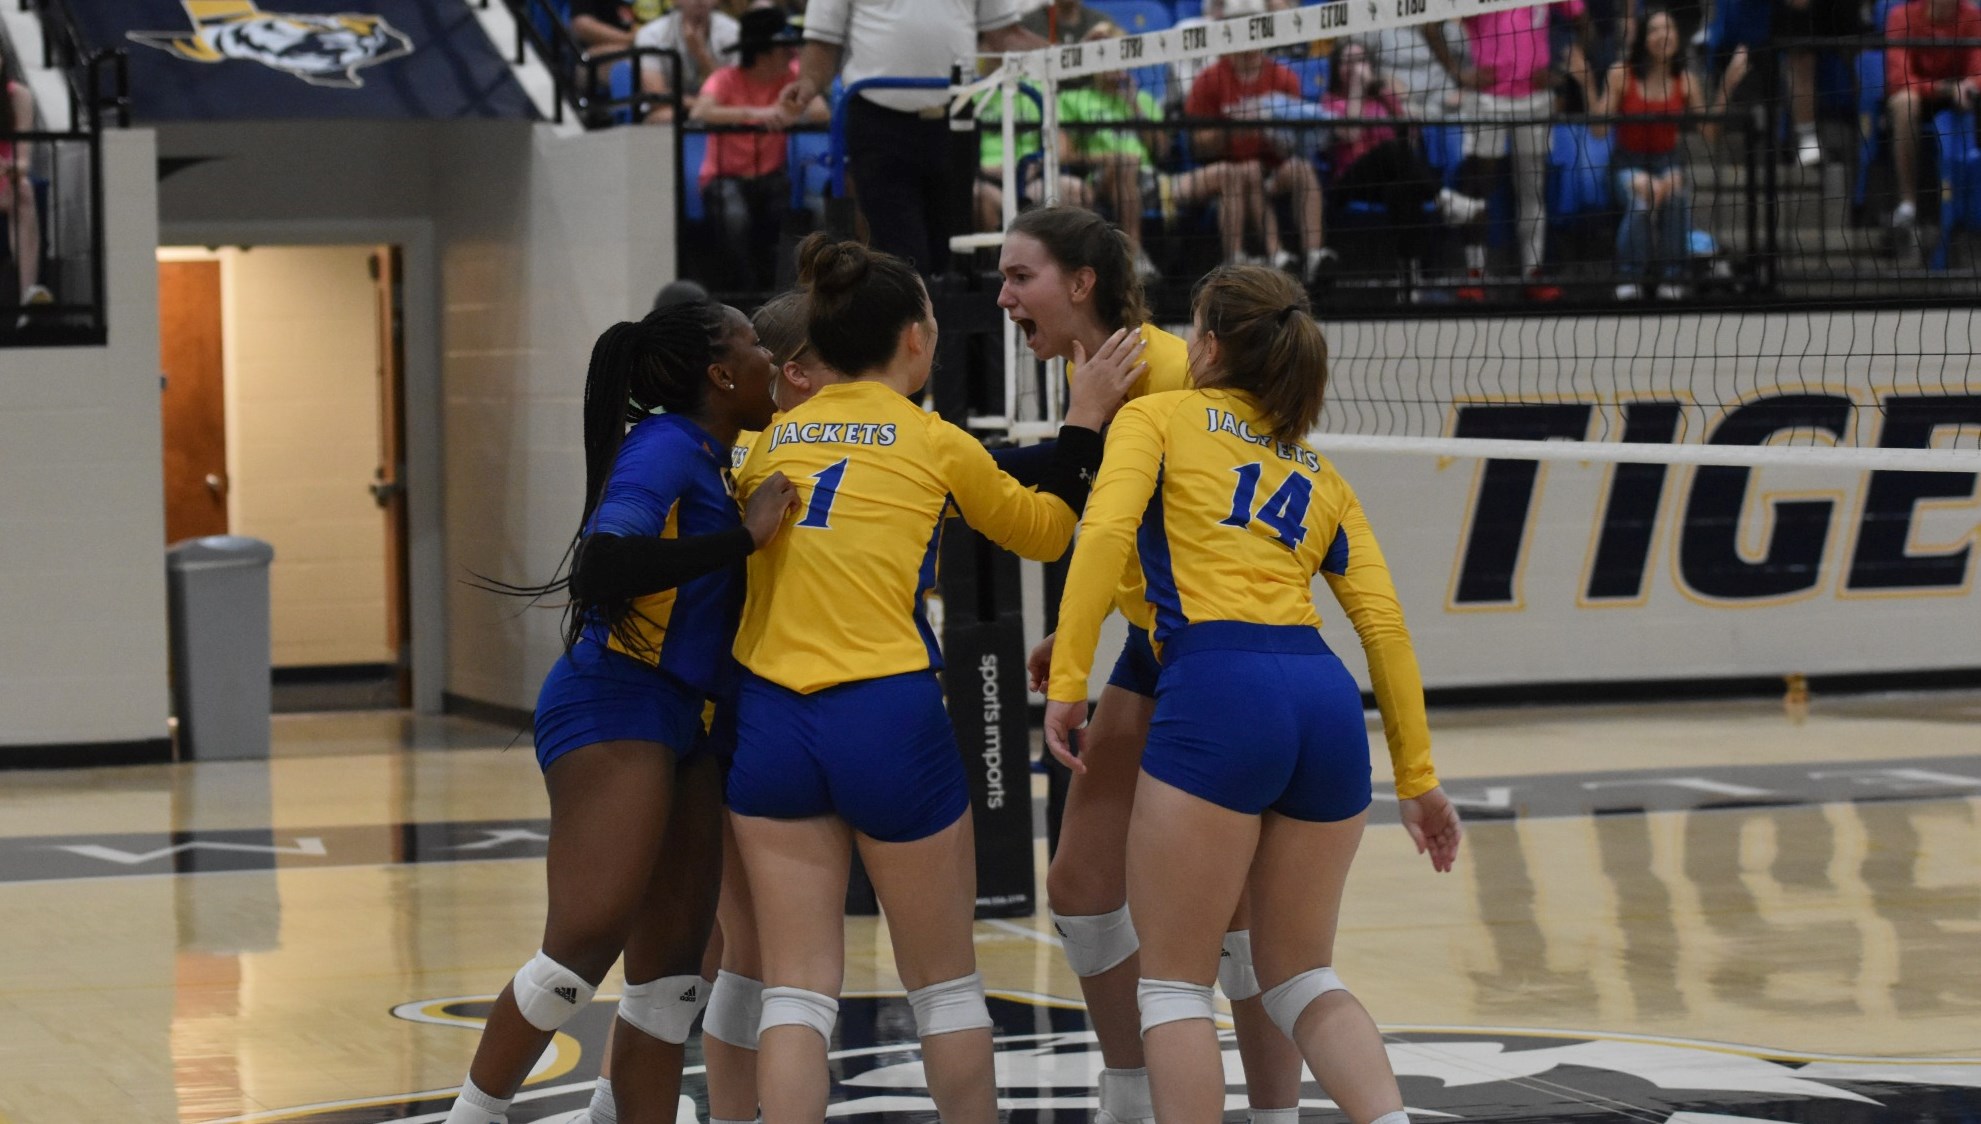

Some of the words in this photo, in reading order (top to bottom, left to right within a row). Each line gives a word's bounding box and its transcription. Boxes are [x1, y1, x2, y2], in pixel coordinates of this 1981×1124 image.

[1249, 15, 1275, 41] ETBU
[1320, 2, 1348, 30] ETBU
[768, 421, 896, 453] JACKETS
[793, 456, 850, 530] 1
[1215, 461, 1313, 552] 14
[978, 654, 1002, 722] sports
[982, 725, 1006, 809] imports
